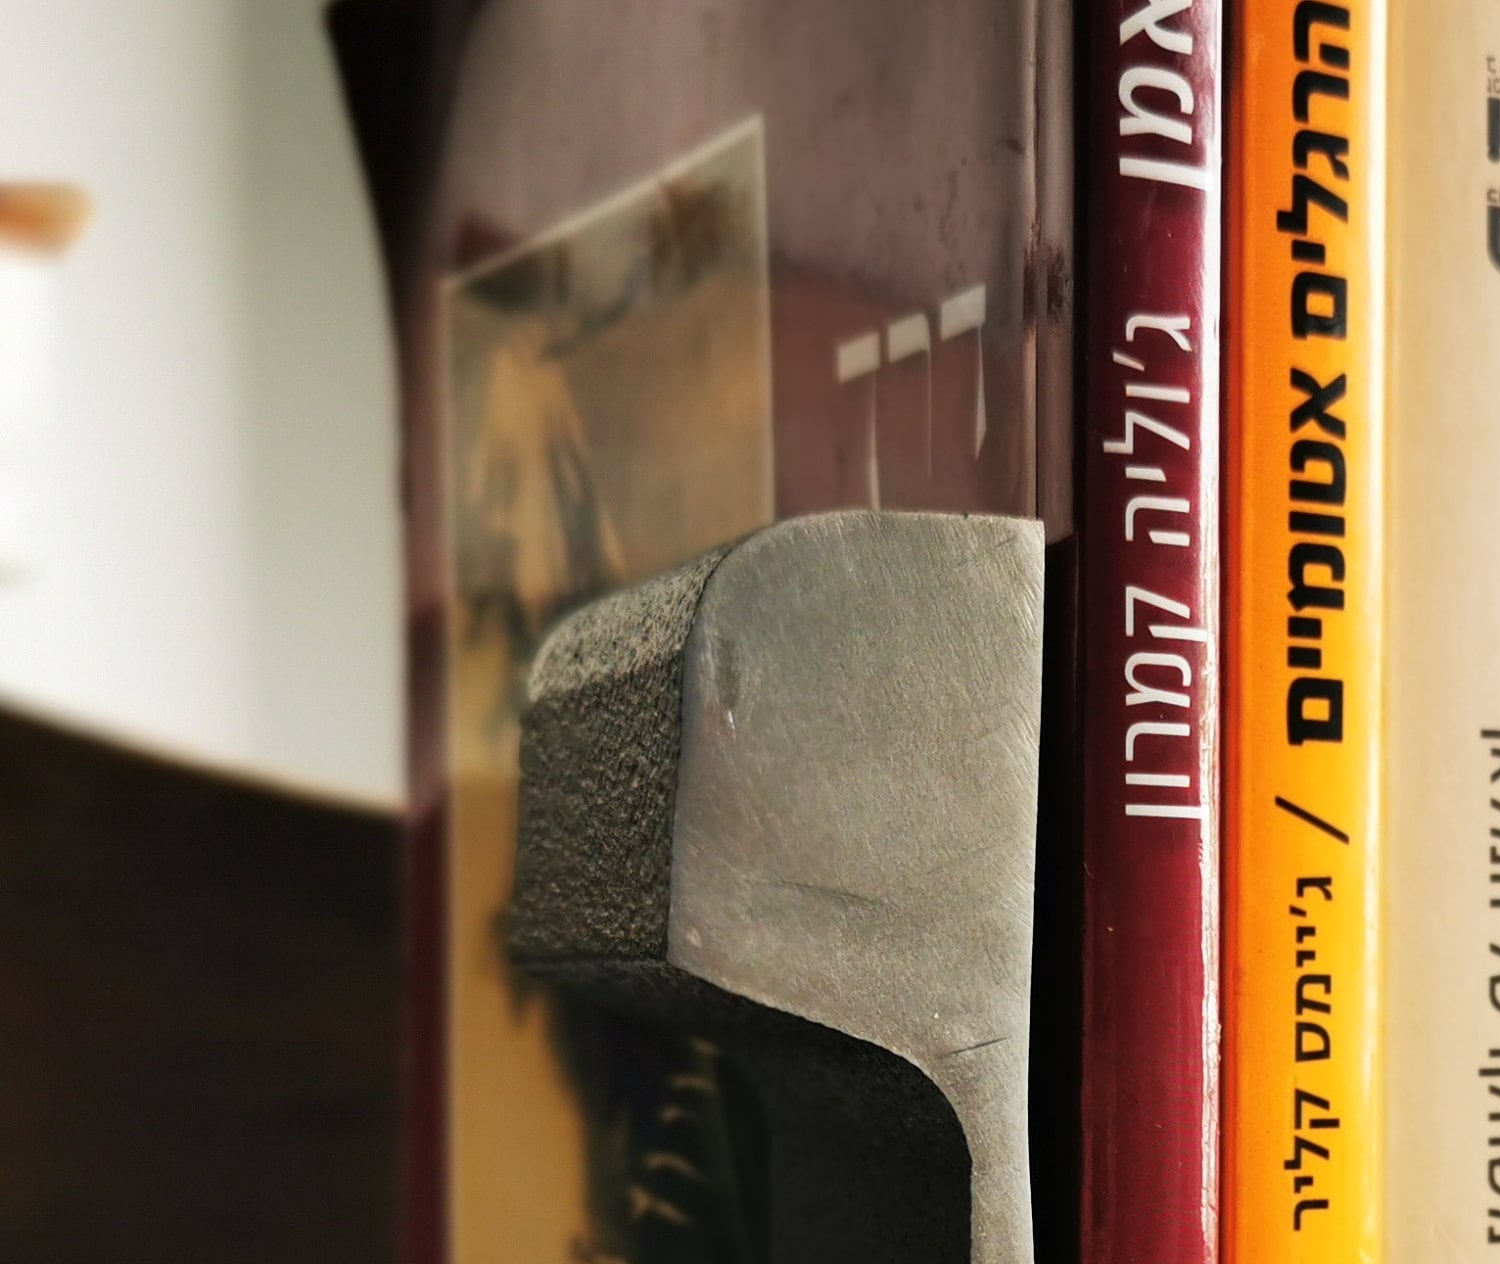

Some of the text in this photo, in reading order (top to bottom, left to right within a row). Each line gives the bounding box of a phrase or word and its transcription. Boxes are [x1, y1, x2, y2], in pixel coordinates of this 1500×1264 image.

[1275, 0, 1351, 341] הרגלים
[1103, 313, 1193, 546] ג'וליה
[1286, 366, 1347, 746] אטומיים
[1124, 585, 1214, 819] קמרון
[1289, 875, 1333, 1063] ג'יימס
[1282, 1088, 1340, 1232] קליר
